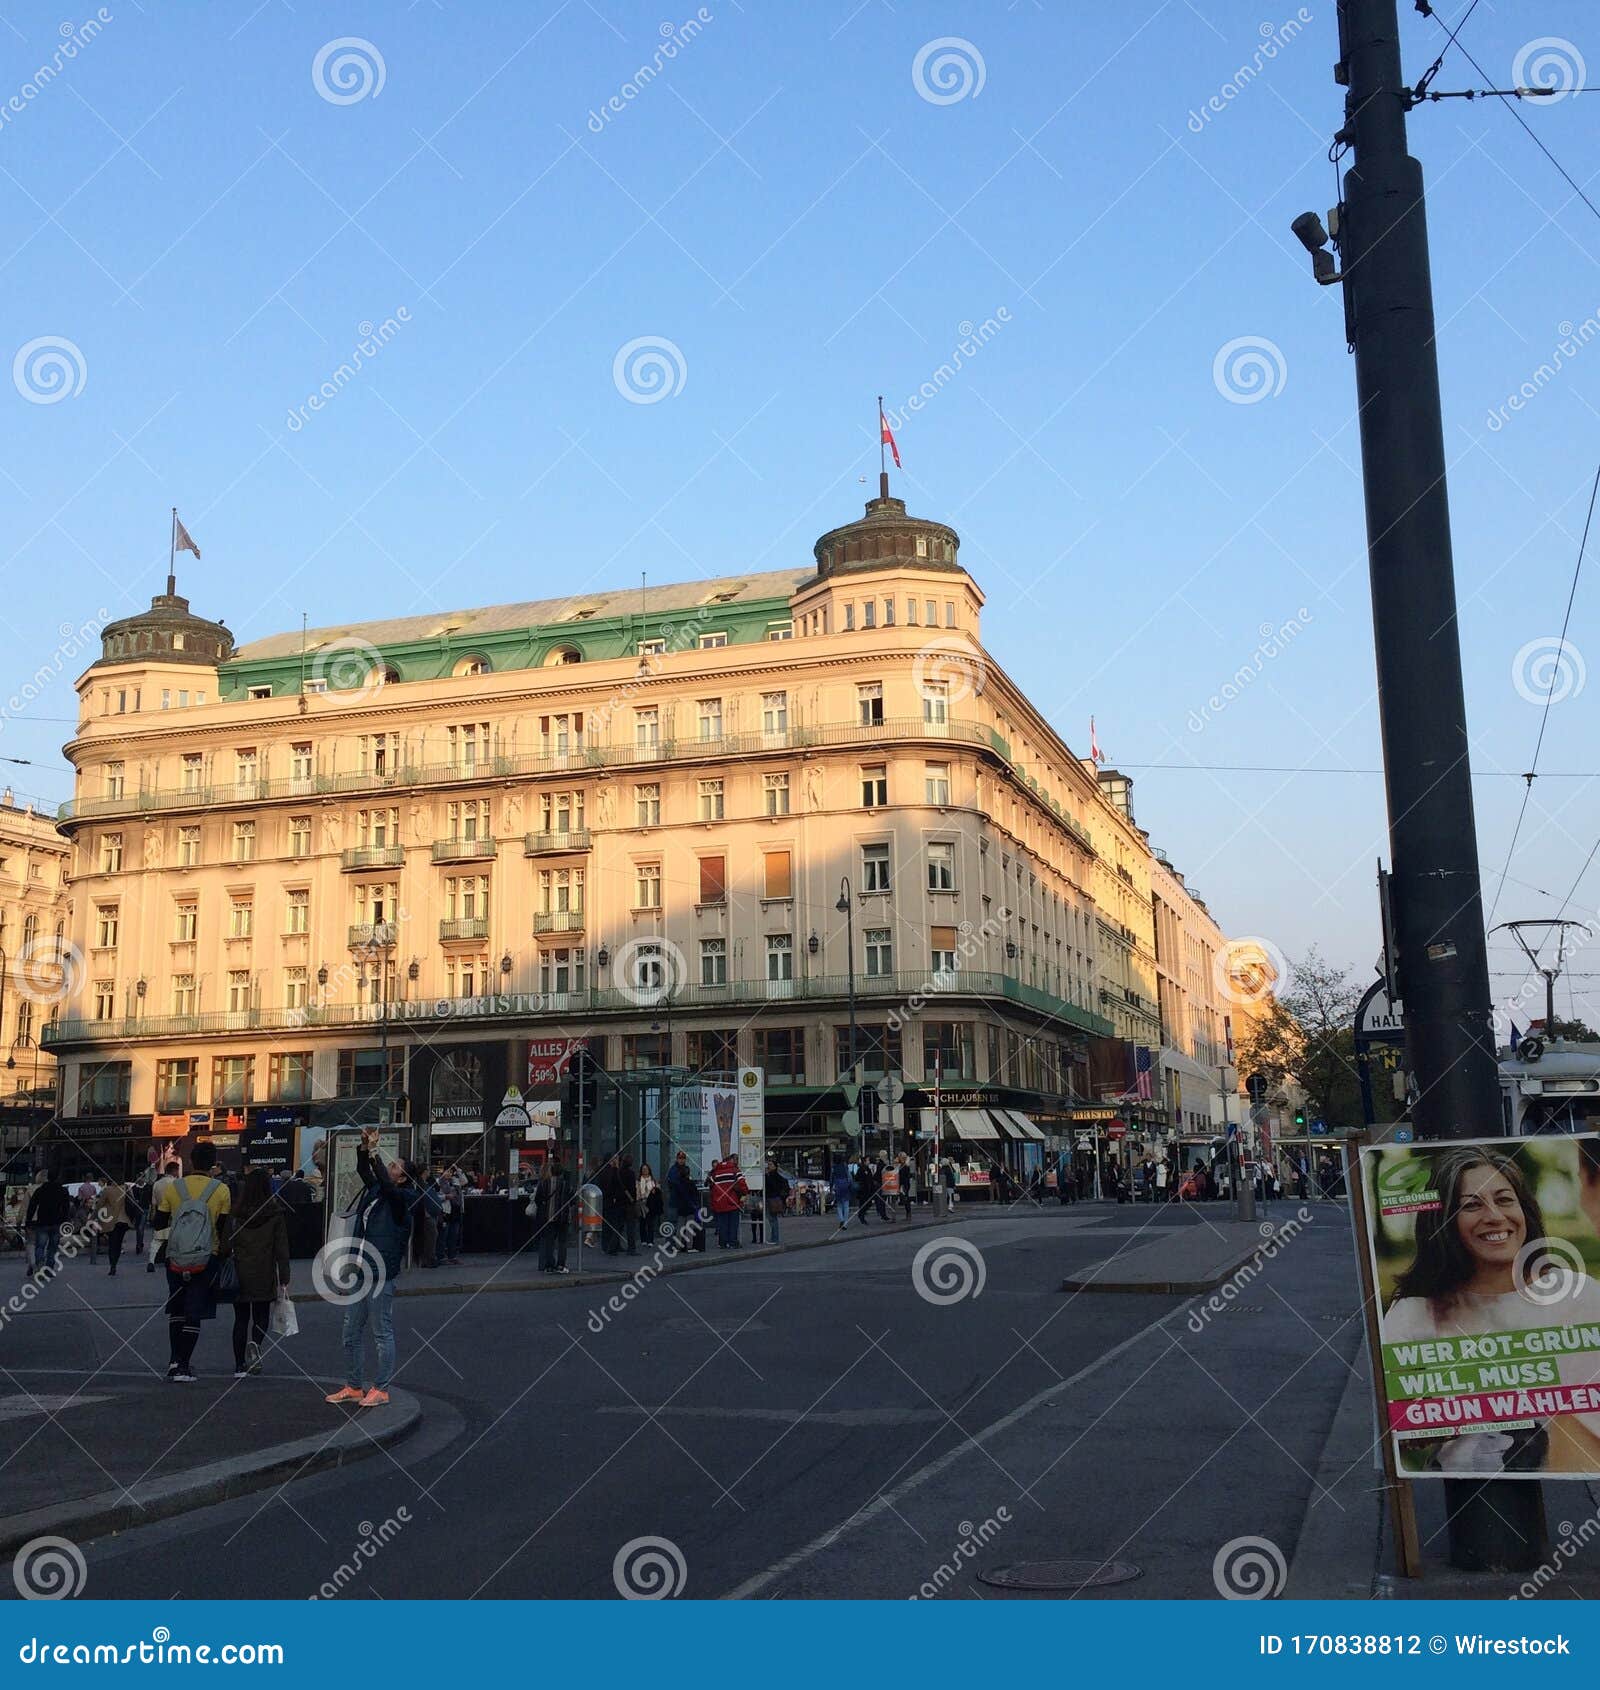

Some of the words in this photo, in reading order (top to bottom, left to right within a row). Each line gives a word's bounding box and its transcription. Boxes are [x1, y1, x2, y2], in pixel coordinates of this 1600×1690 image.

[352, 1000, 432, 1021] HOTEL
[455, 991, 560, 1017] BRISTOL
[530, 1043, 563, 1057] ALLES
[1526, 1040, 1539, 1058] 2
[1384, 1055, 1396, 1069] N
[531, 1069, 555, 1082] -50%
[431, 1106, 444, 1118] SIR
[445, 1105, 482, 1118] ANTHONY
[1382, 1196, 1398, 1205] DIE
[1398, 1191, 1438, 1204] GRÜNEN
[1392, 1342, 1455, 1366] WER
[1459, 1324, 1600, 1360] ROT-GRÜN
[1398, 1370, 1475, 1396] WILL,
[1478, 1361, 1555, 1387] MUSS
[1406, 1395, 1482, 1424] GRÜN
[1418, 1427, 1453, 1437] OKTOBER
[1461, 1424, 1486, 1434] MARIA
